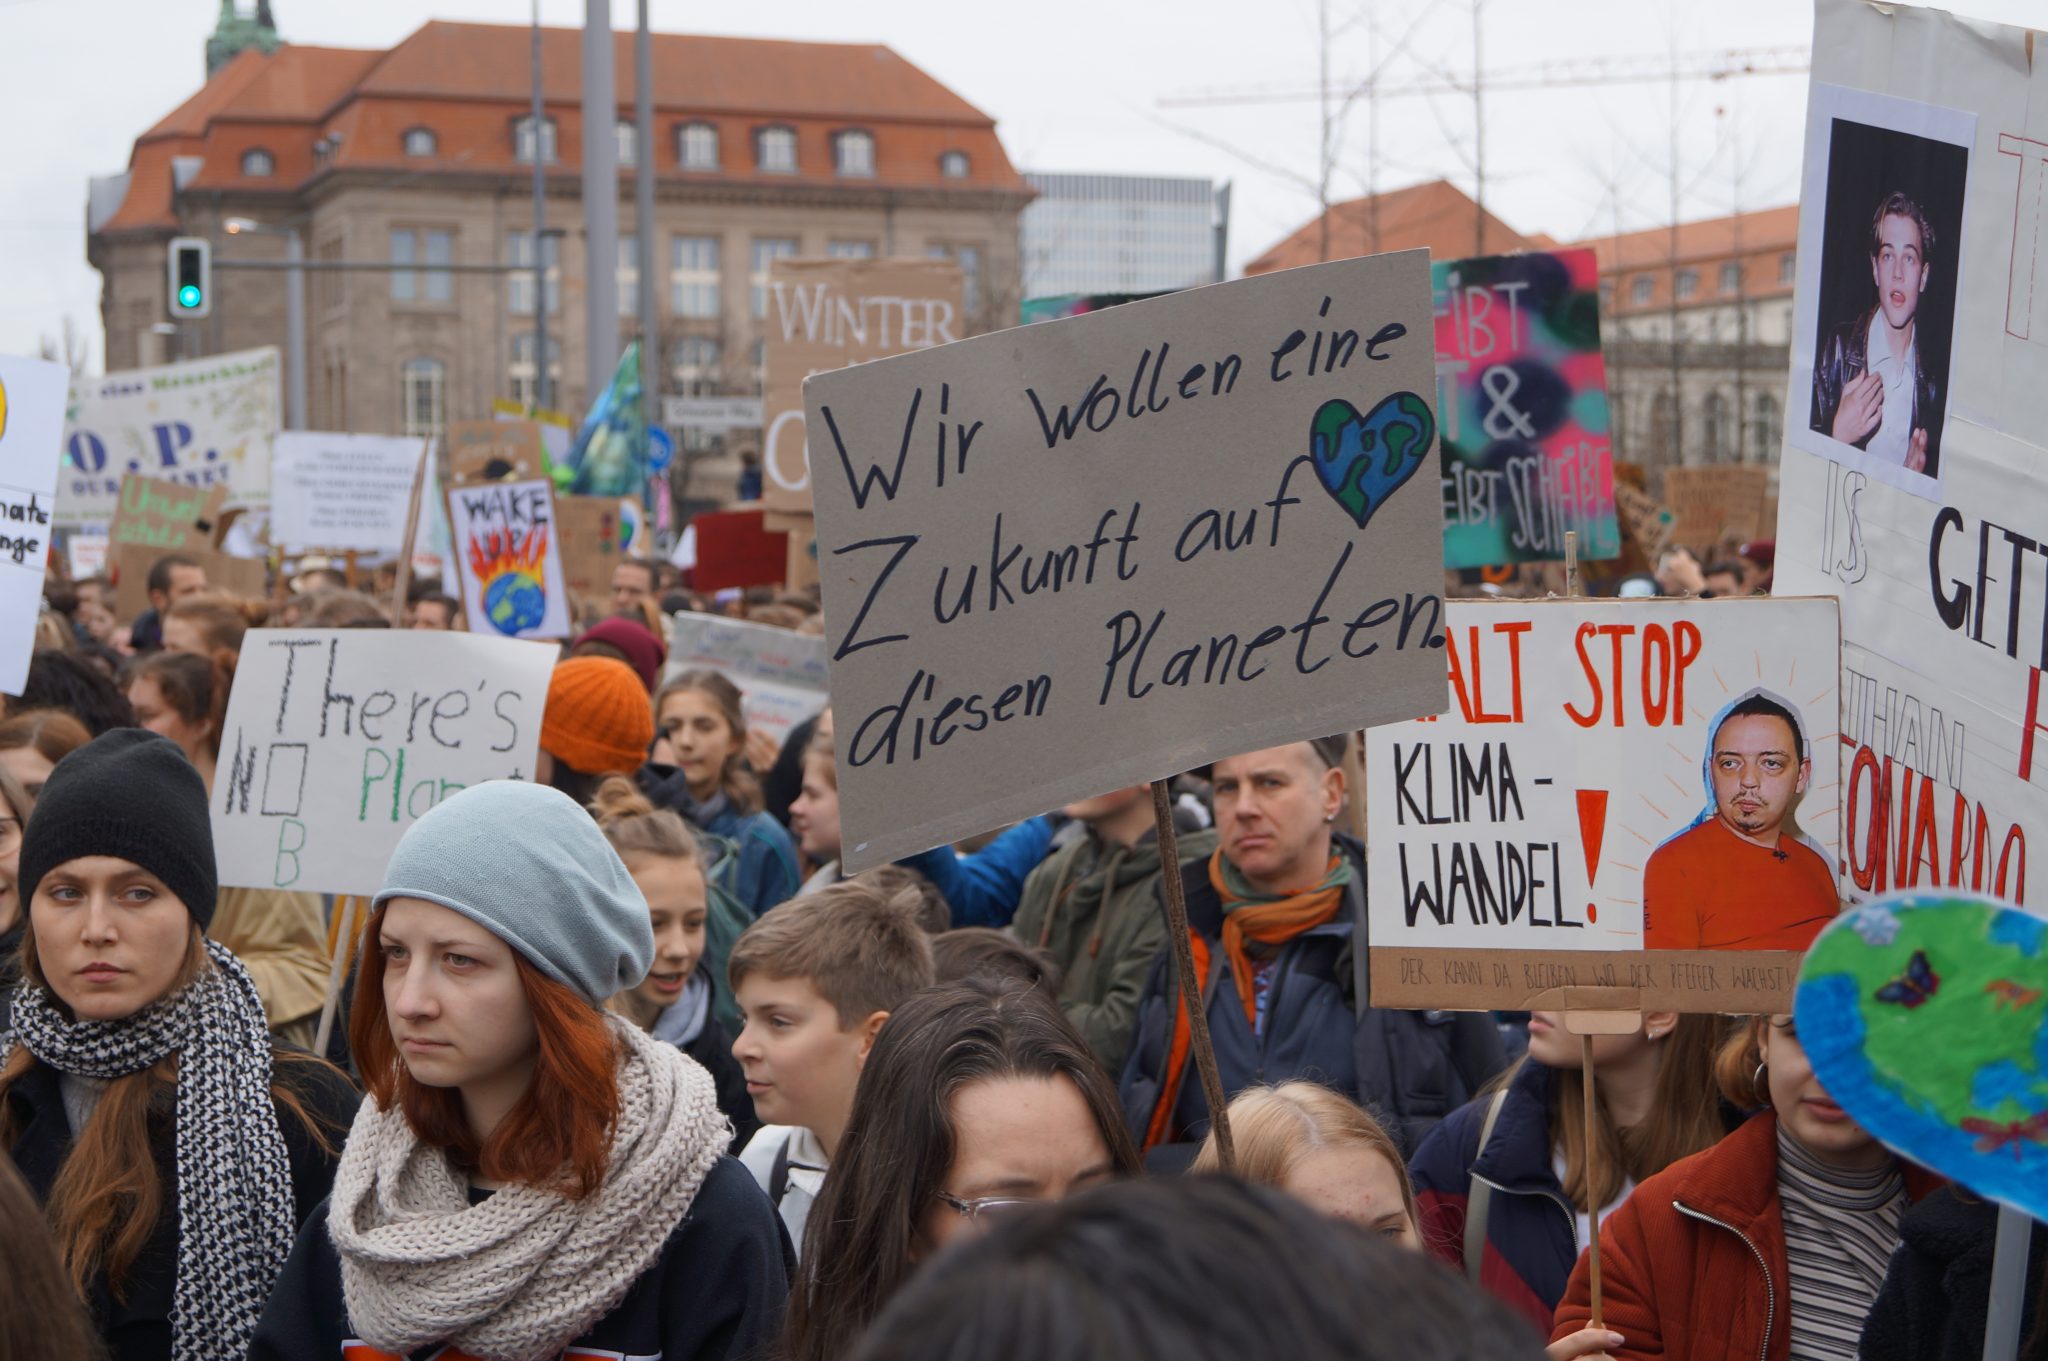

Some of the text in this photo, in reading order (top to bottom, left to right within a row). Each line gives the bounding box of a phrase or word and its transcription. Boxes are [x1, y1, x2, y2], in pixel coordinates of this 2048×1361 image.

[772, 281, 956, 348] WINTER
[1432, 270, 1530, 358] EIBT
[820, 382, 983, 509] Wir
[1025, 342, 1241, 448] wollen
[1270, 297, 1407, 382] eine
[1481, 364, 1536, 440] &
[462, 487, 548, 525] WAKE
[1438, 460, 1505, 530] EIBT
[1820, 459, 1868, 585] IS
[833, 454, 1314, 661] Zukunft auf
[267, 637, 523, 752] There's
[848, 541, 1446, 768] diesen Planeten.
[1416, 619, 1703, 729] ALT STOP
[225, 726, 309, 817] NO
[1846, 666, 1965, 792] THAN
[272, 818, 307, 888] B
[1399, 789, 1609, 928] WANDEL!
[1840, 732, 2026, 907] ONARDO
[1400, 957, 1432, 985] DER
[1443, 957, 1483, 986] KANN
[1493, 963, 1512, 988] DA
[1629, 963, 1658, 989] DER
